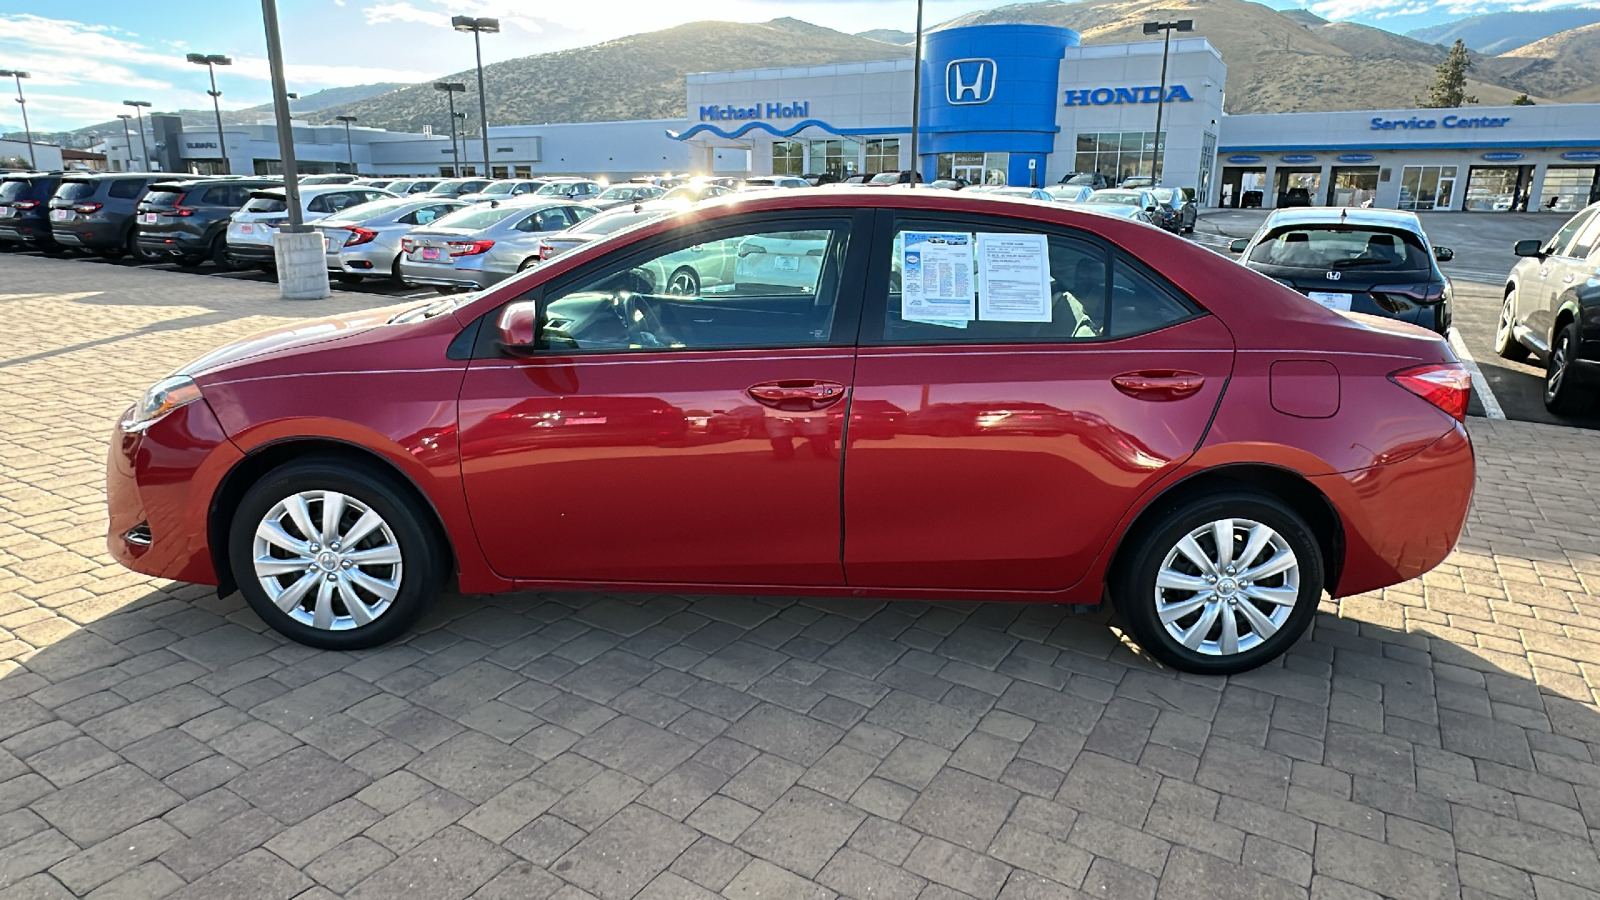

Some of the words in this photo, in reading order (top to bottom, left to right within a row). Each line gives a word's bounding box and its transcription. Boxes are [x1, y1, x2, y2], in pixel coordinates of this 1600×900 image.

[1064, 85, 1194, 107] HONDA
[699, 103, 761, 121] Michael
[766, 101, 809, 119] Hohl
[1370, 116, 1437, 131] Service
[1441, 115, 1511, 129] Center
